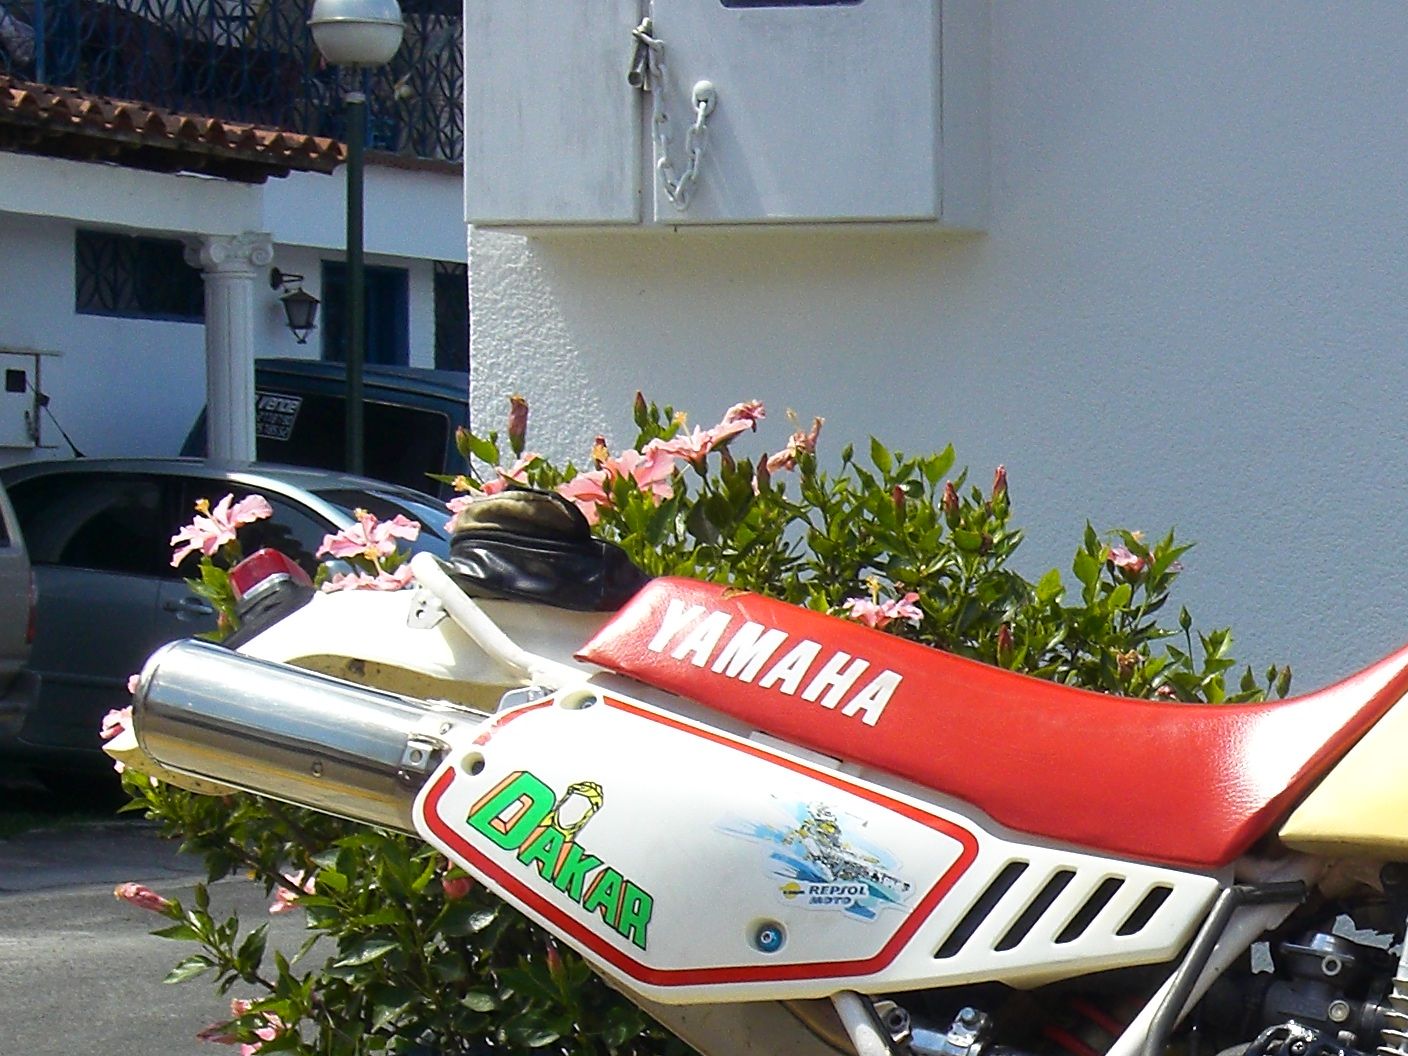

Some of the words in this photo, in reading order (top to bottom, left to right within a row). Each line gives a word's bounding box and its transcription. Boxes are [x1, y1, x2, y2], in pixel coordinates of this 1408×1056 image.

[647, 599, 903, 727] YAMAHA
[465, 770, 654, 951] DAKAR
[808, 885, 866, 895] REPSOL
[809, 896, 851, 905] MOTO
